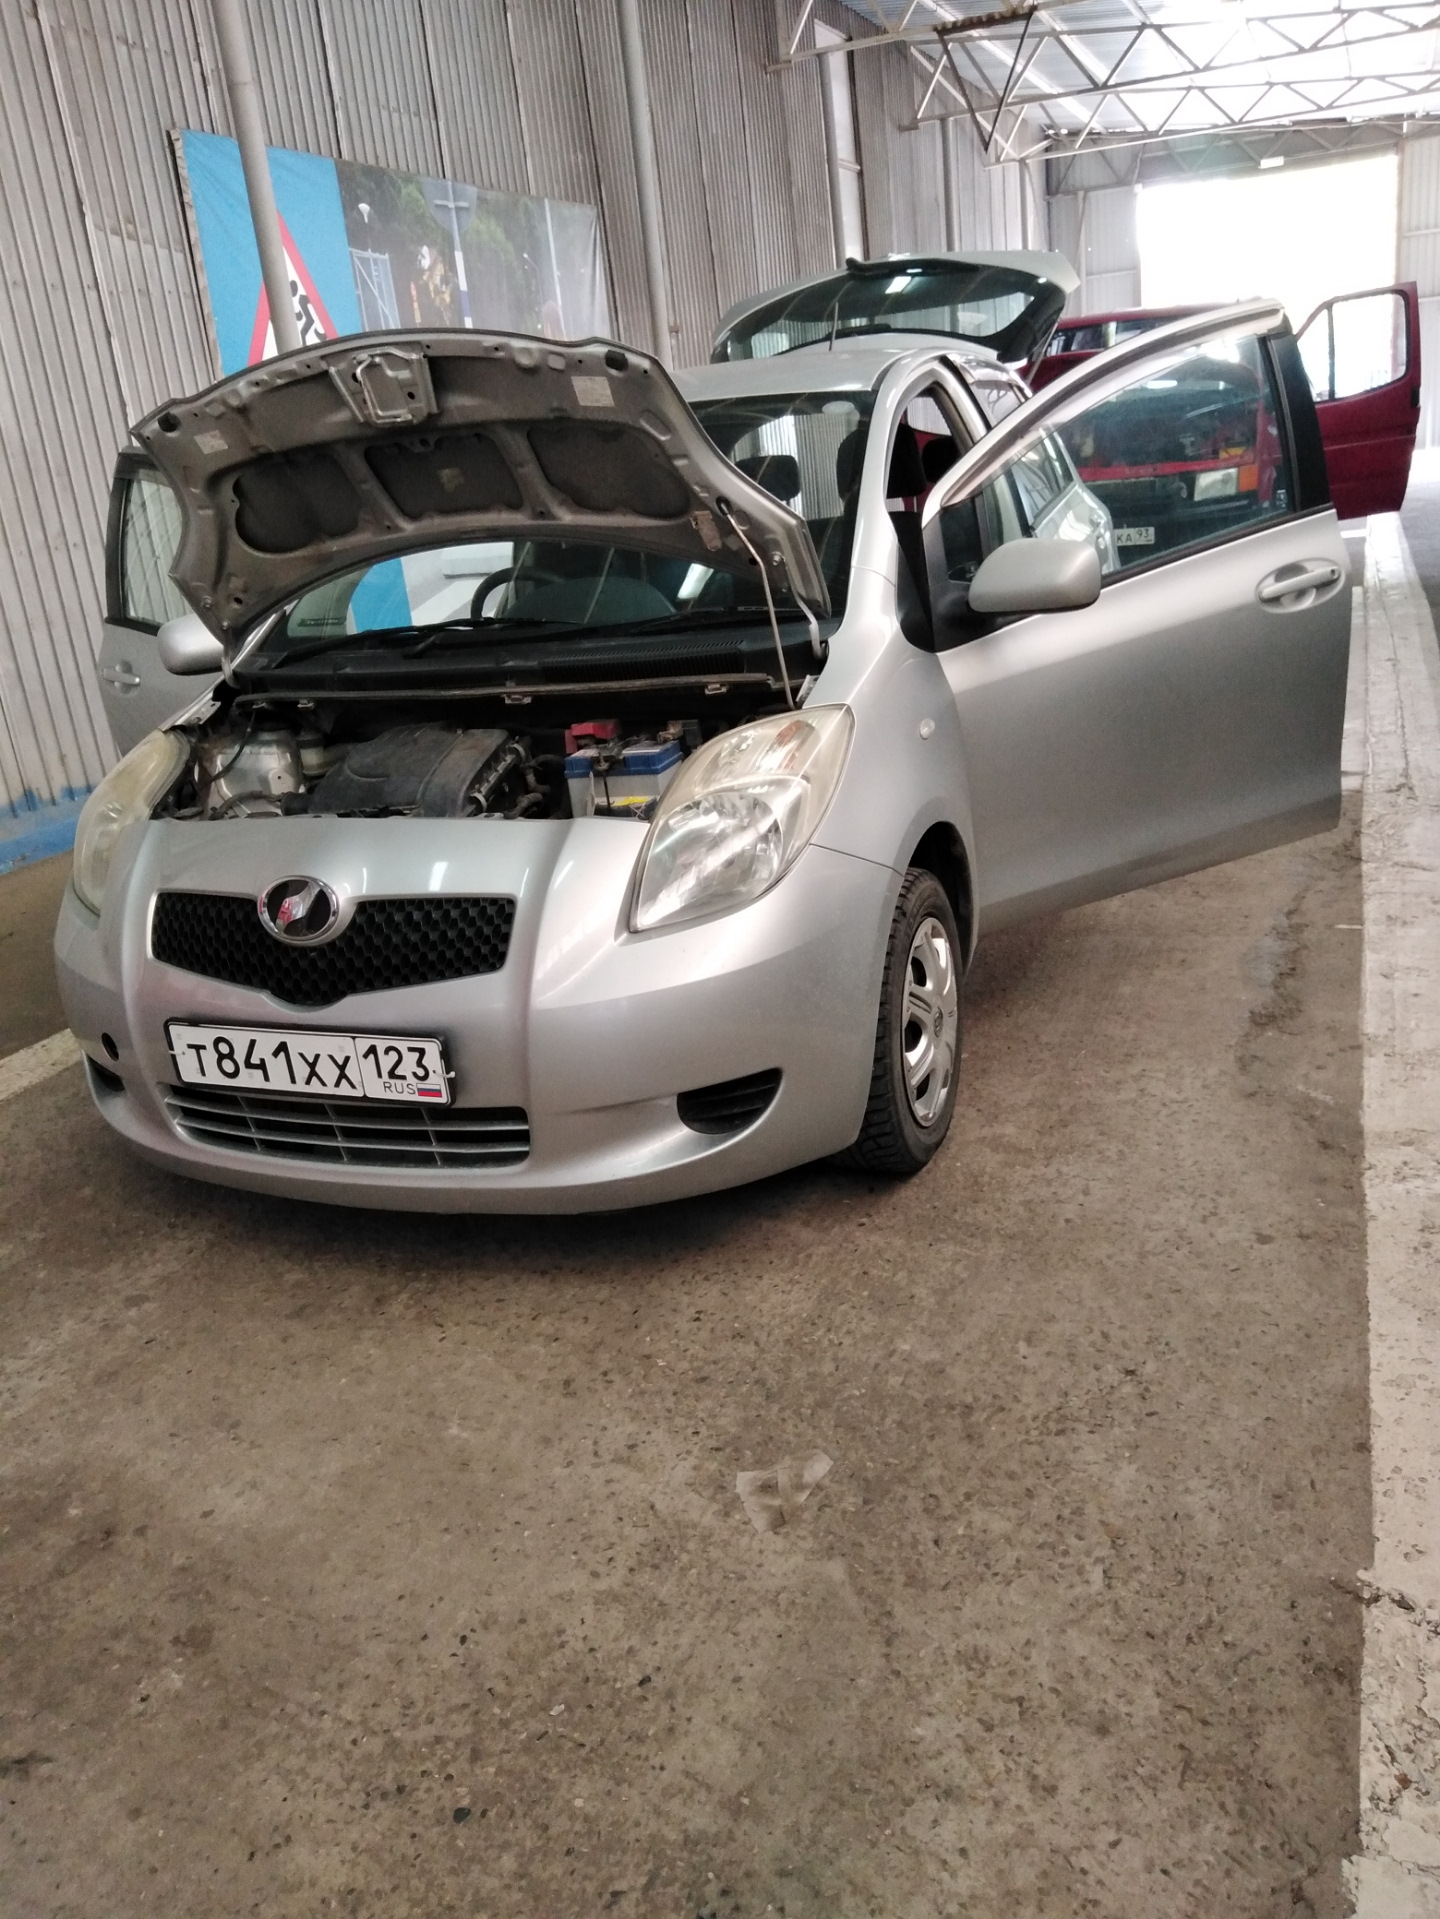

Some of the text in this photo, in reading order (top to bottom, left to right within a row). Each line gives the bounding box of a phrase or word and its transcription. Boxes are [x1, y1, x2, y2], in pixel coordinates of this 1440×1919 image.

[186, 1036, 430, 1090] T841XX 123
[382, 1081, 416, 1096] RUS
